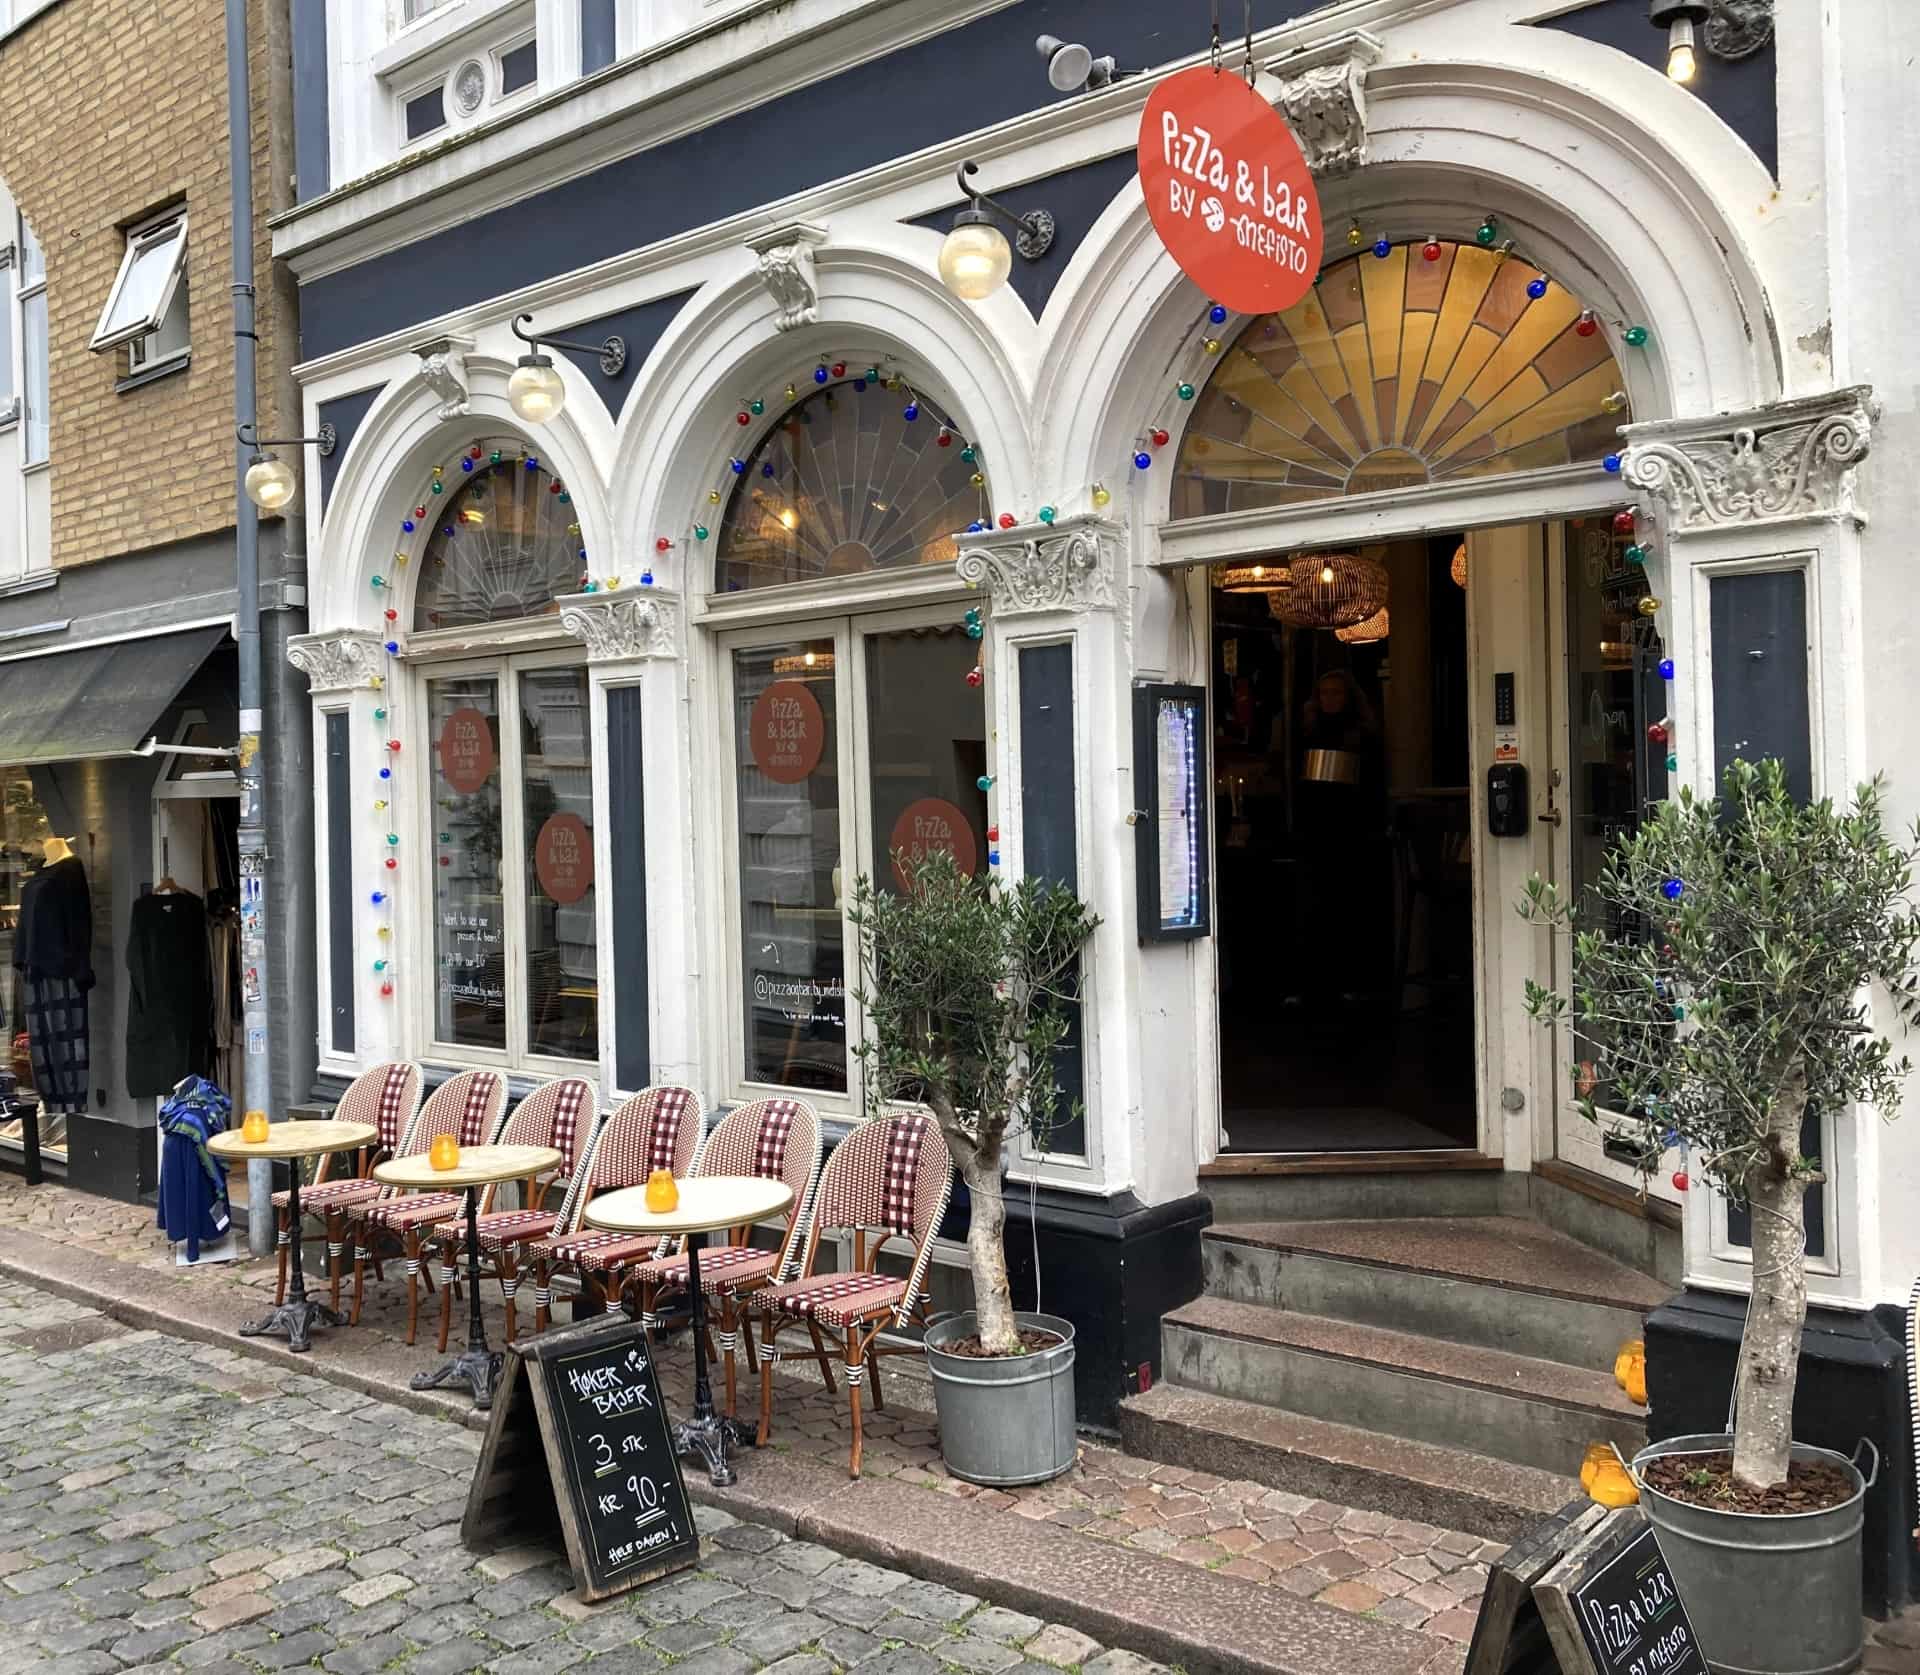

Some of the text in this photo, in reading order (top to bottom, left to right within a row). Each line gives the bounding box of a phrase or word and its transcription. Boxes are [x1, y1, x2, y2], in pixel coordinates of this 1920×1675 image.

[1162, 111, 1230, 192] Pizza
[1236, 159, 1256, 207] &
[568, 1365, 624, 1399] HØKER
[592, 1383, 652, 1416] BAJER
[588, 1433, 613, 1466] 3
[608, 1540, 633, 1564] HELE
